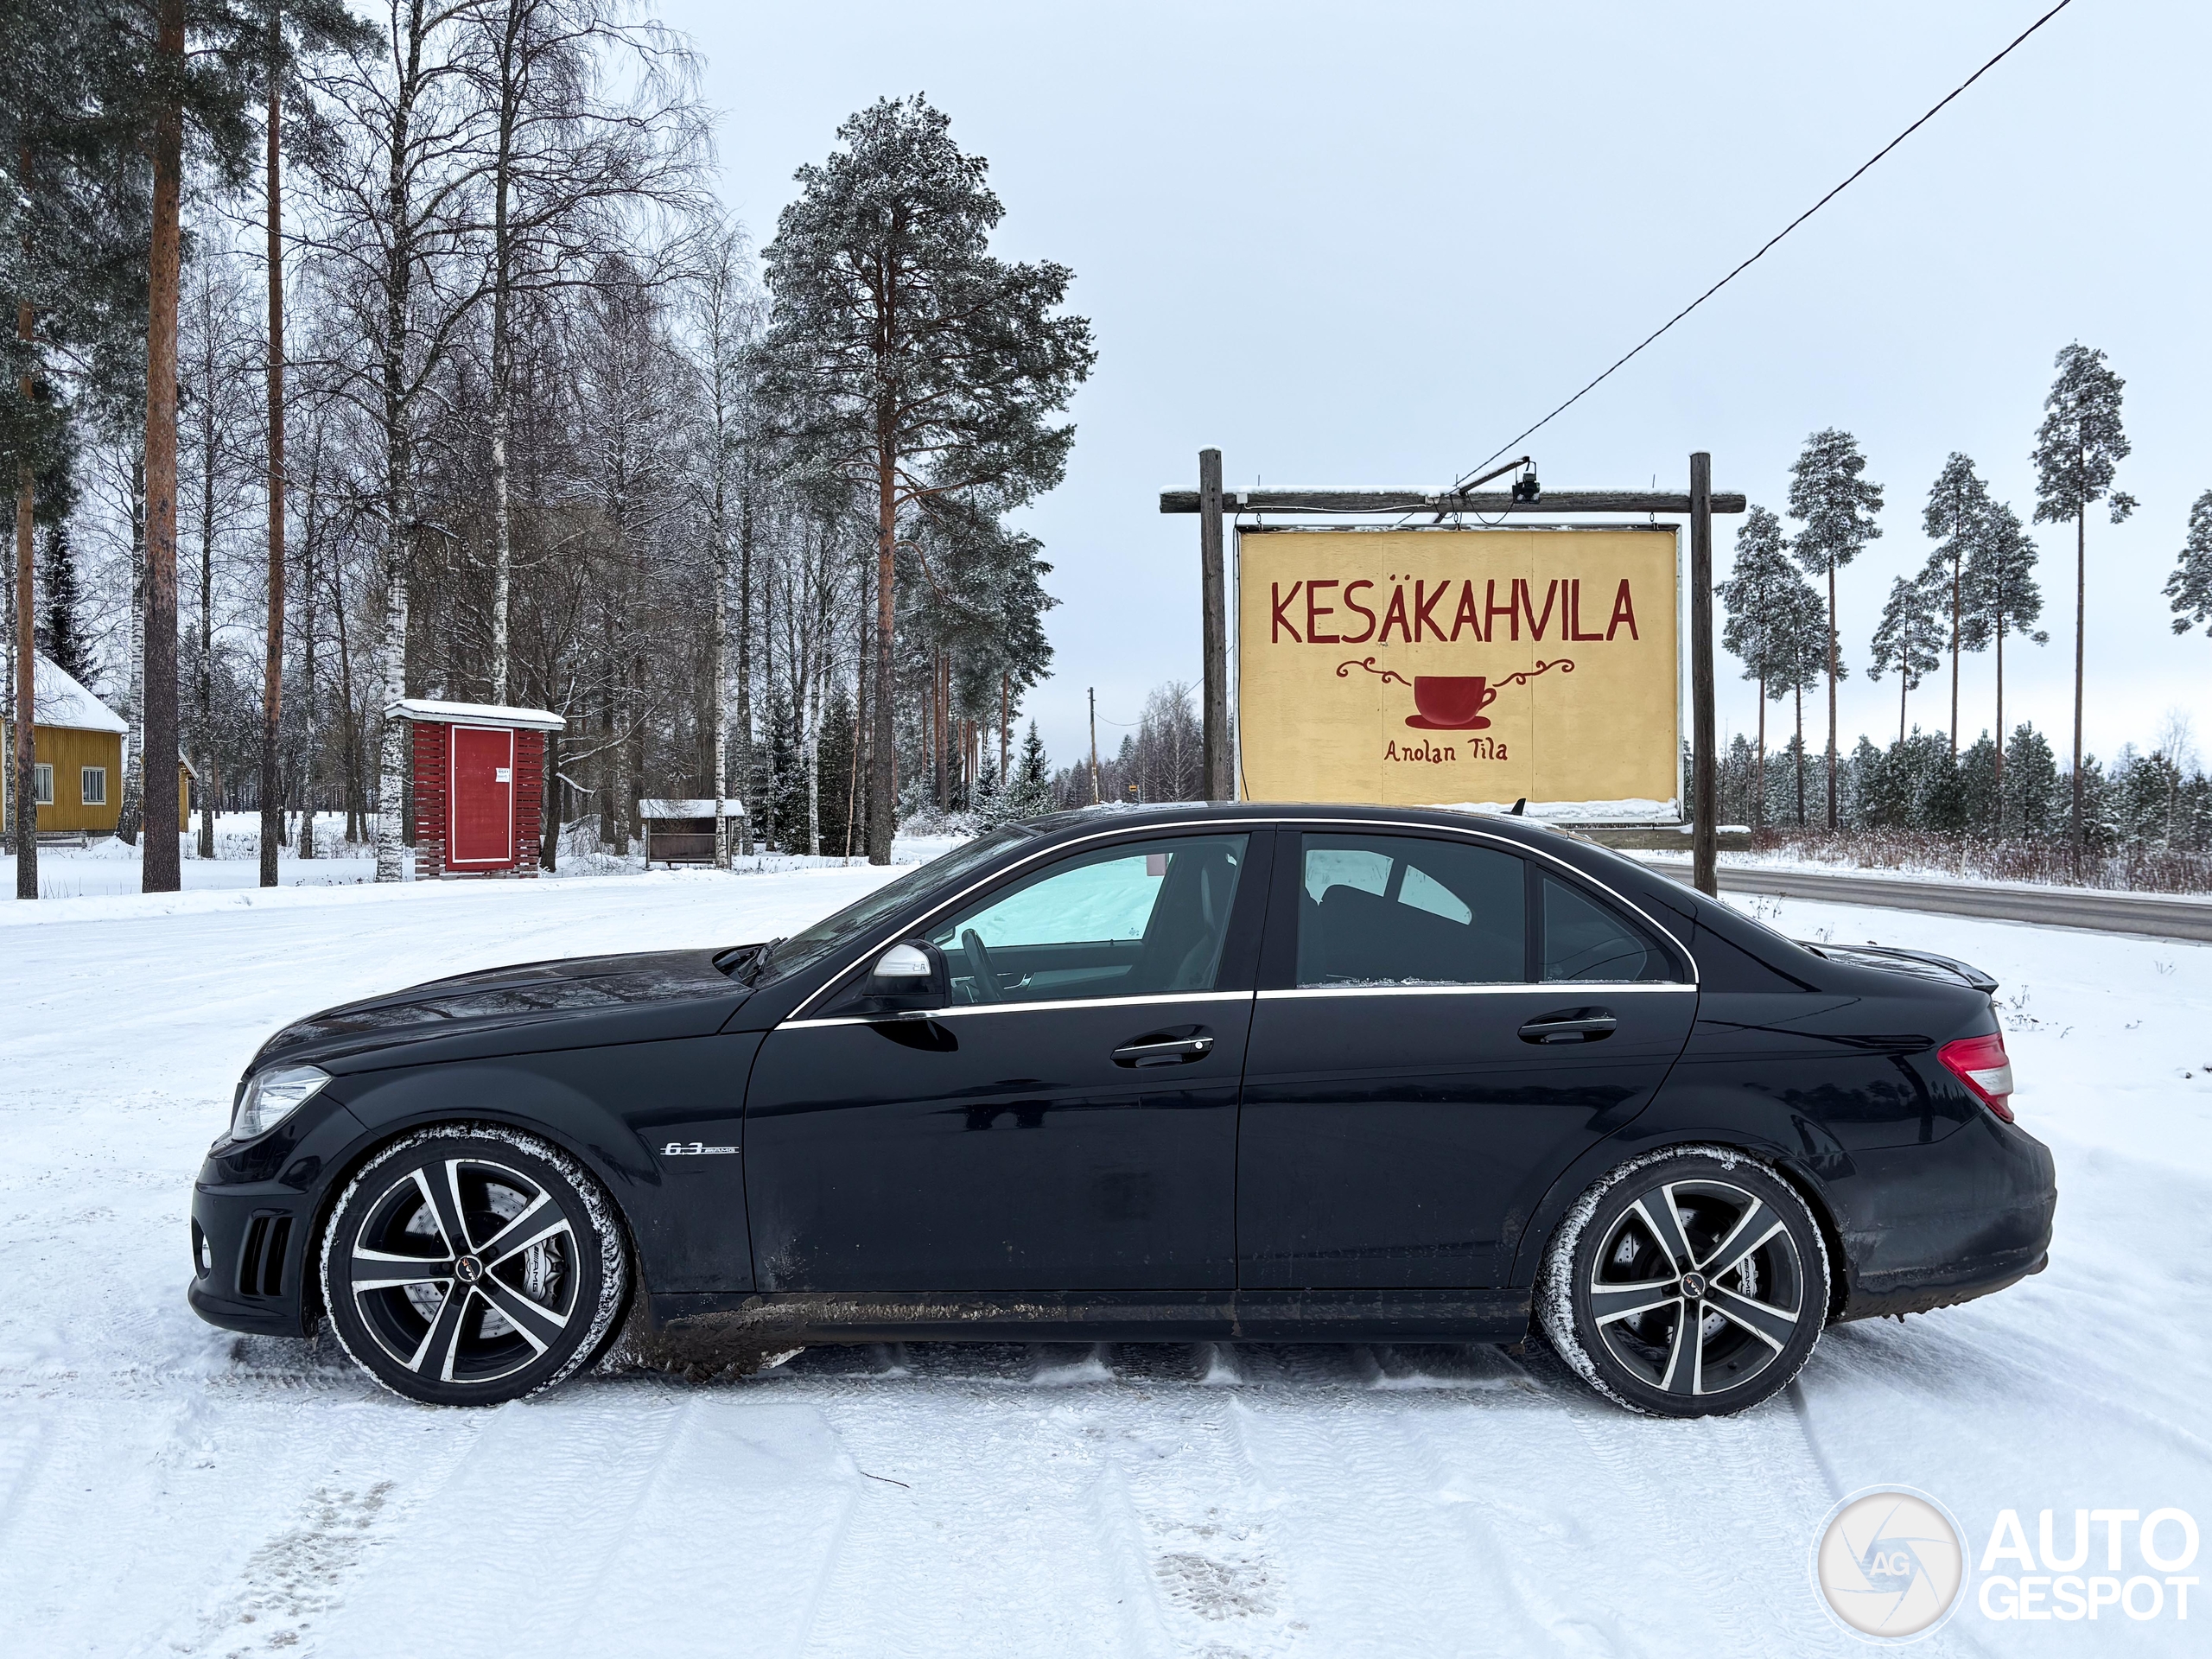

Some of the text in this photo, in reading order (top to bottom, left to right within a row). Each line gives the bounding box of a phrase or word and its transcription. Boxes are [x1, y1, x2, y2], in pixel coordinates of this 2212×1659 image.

[1271, 574, 1640, 644] KESÄKAHVILA
[1384, 737, 1508, 764] Anolan Tila
